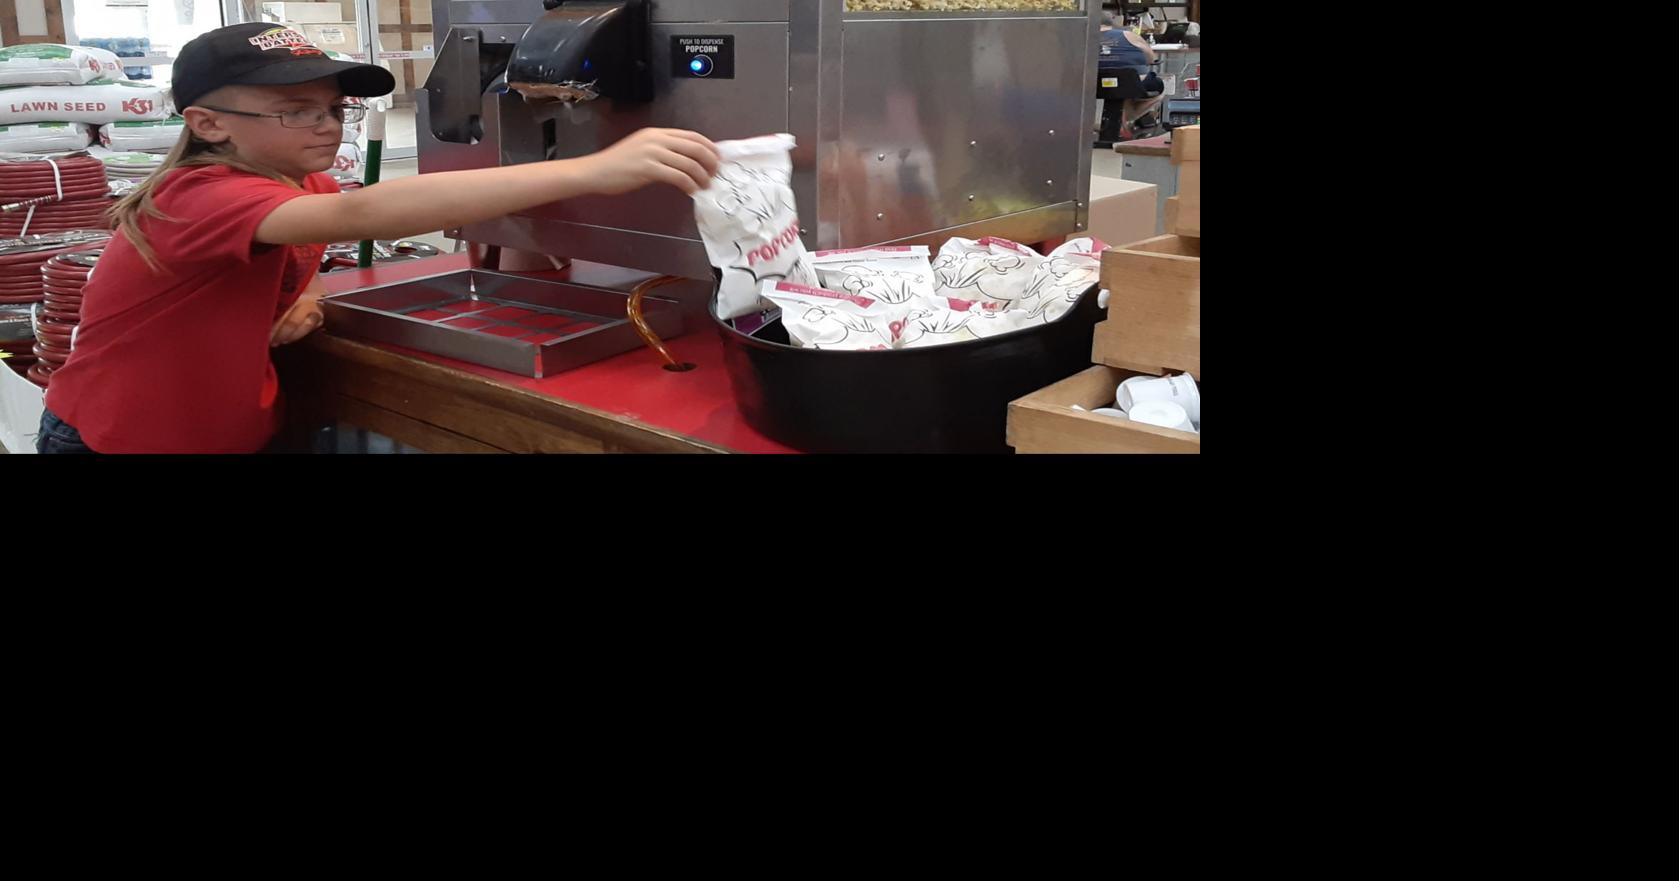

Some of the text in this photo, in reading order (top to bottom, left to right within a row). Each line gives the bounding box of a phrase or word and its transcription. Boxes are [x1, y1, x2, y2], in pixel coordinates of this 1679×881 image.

[685, 45, 718, 53] POPCORN
[11, 101, 106, 113] LAWN SEED
[122, 97, 153, 115] K31
